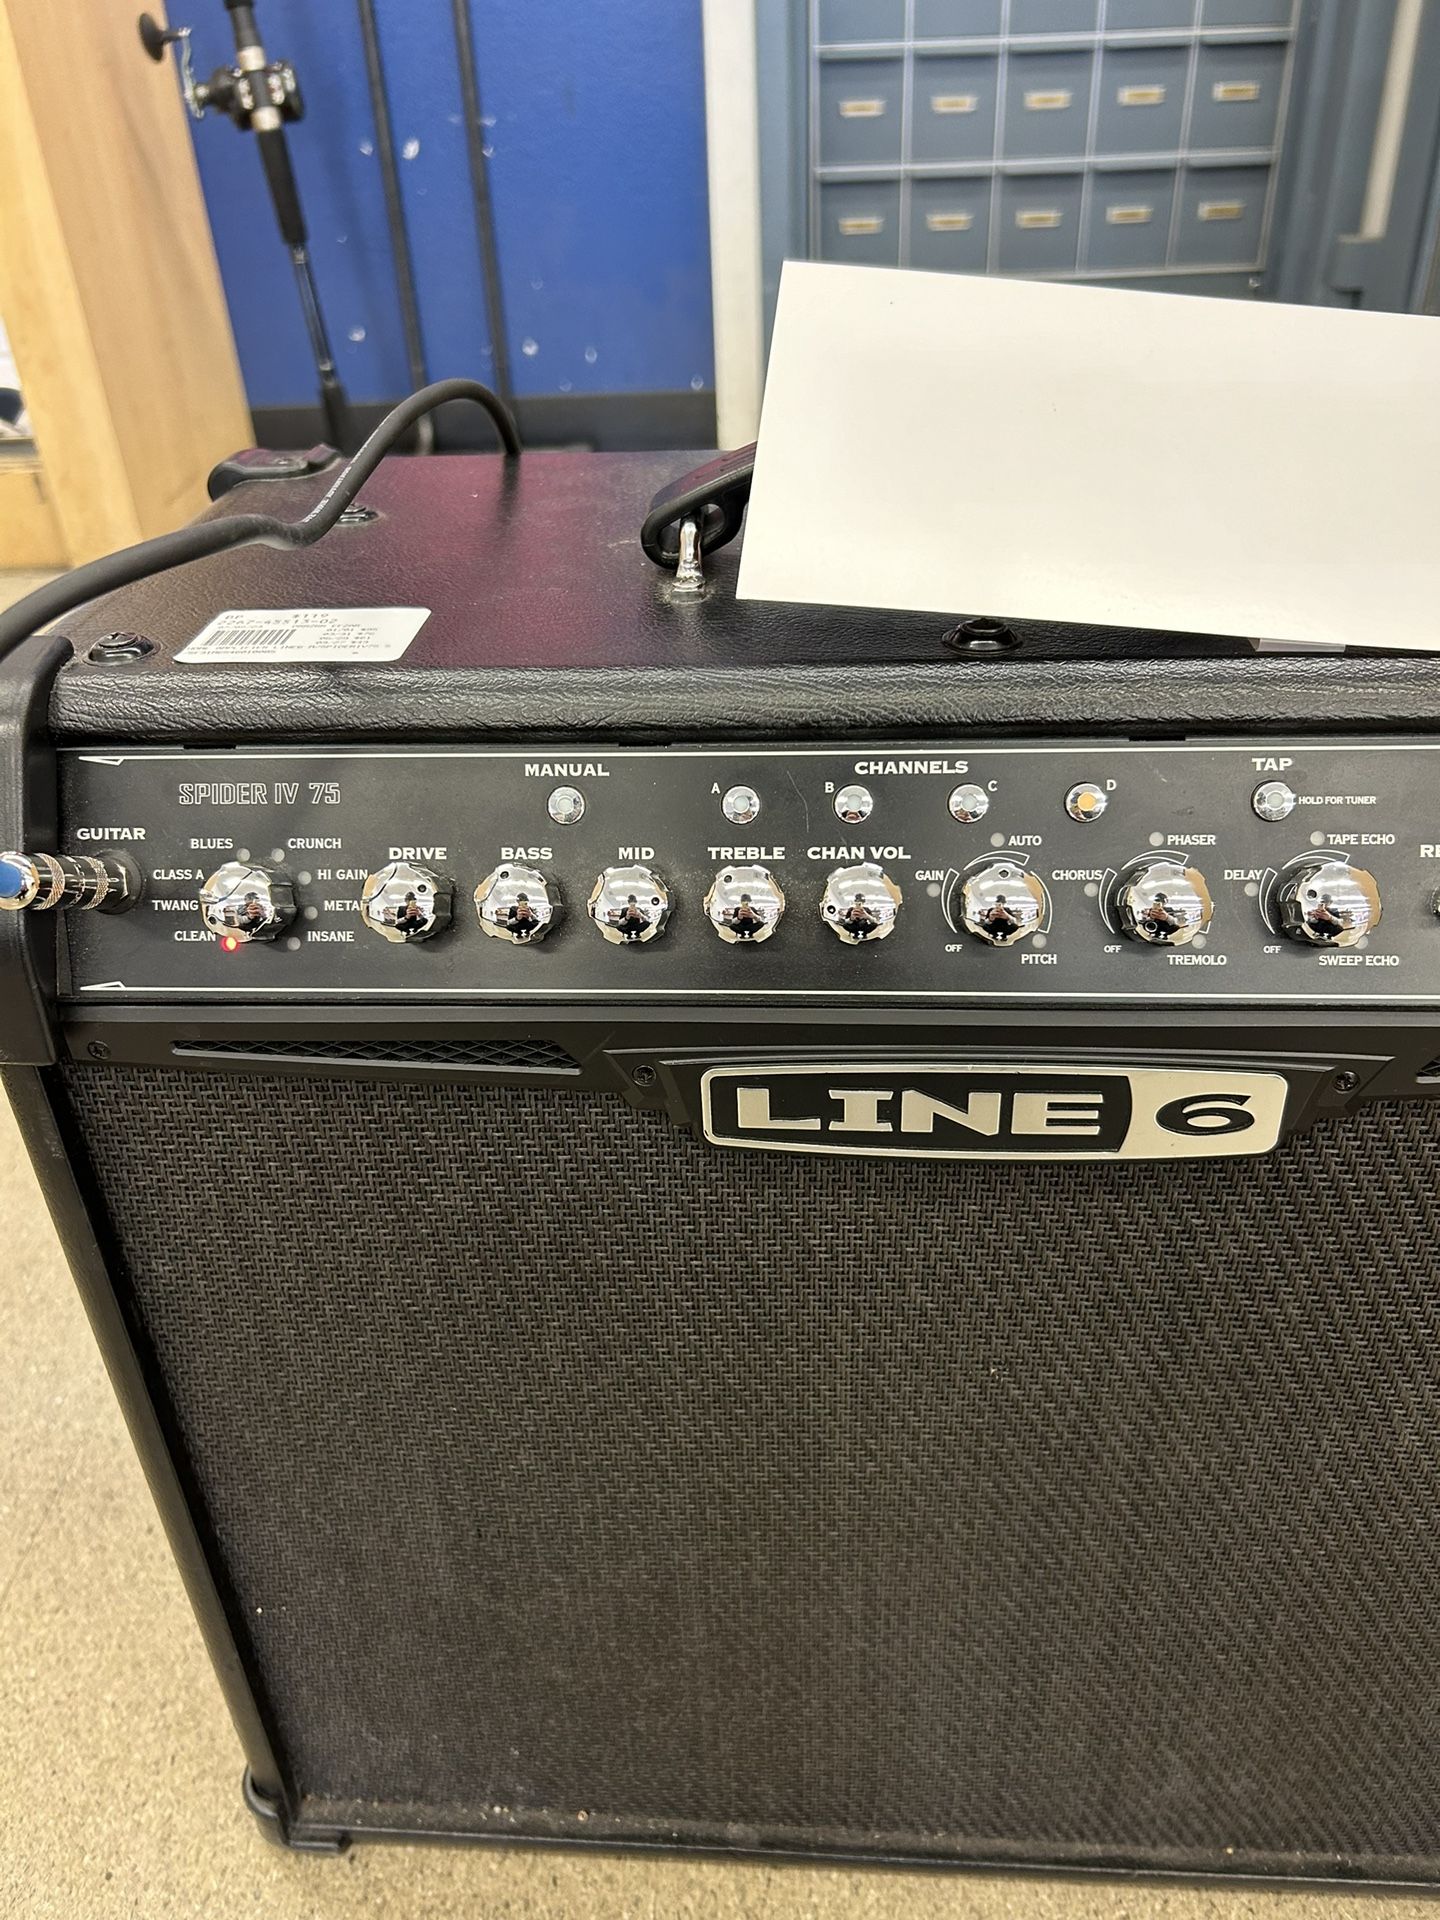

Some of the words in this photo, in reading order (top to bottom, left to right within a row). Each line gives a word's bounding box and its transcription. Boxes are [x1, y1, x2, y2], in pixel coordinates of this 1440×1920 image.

[524, 763, 610, 777] MANUAL
[854, 761, 969, 775] CHANNELS
[1252, 758, 1293, 771] TAP
[711, 783, 721, 794] A
[825, 782, 834, 793] B
[987, 780, 998, 792] C
[1106, 780, 1117, 791] D
[179, 783, 267, 805] SPIDER
[274, 783, 299, 805] IV
[308, 783, 341, 805] 75
[1298, 796, 1323, 805] HOLD
[1325, 796, 1342, 805] FOR
[1345, 796, 1377, 805] TUNER
[77, 827, 146, 840] GUITAR
[190, 838, 234, 849] BLUES
[287, 837, 342, 849] CRUNCH
[1008, 835, 1042, 846] AUTO
[1167, 834, 1216, 846] PHASER
[1327, 834, 1358, 845] TAPE
[1361, 834, 1395, 845] ECHO
[388, 847, 447, 860] DRIVE
[501, 847, 553, 860] BASS
[618, 847, 655, 860] MID
[707, 846, 786, 860] TREBLE
[807, 846, 865, 860] CHAN
[869, 846, 912, 860] VOL
[152, 869, 193, 880] CLASS
[195, 869, 205, 880] A
[317, 869, 332, 880] HI
[336, 869, 368, 880] GAIN
[915, 870, 944, 881] GAIN
[1051, 870, 1103, 881] CHORUS
[1224, 870, 1263, 880] DELAY
[152, 900, 199, 911] TWANG
[174, 931, 216, 942] CLEAN
[307, 931, 355, 942] INSANE
[945, 945, 963, 953] OFF
[1263, 946, 1281, 954] OFF
[1021, 954, 1057, 965] PITCH
[1167, 955, 1227, 966] TREMOLO
[1319, 955, 1363, 966] SWEEP
[1365, 956, 1400, 966] ECHO
[736, 1087, 1104, 1137] LINE
[1154, 1094, 1256, 1137] 6
